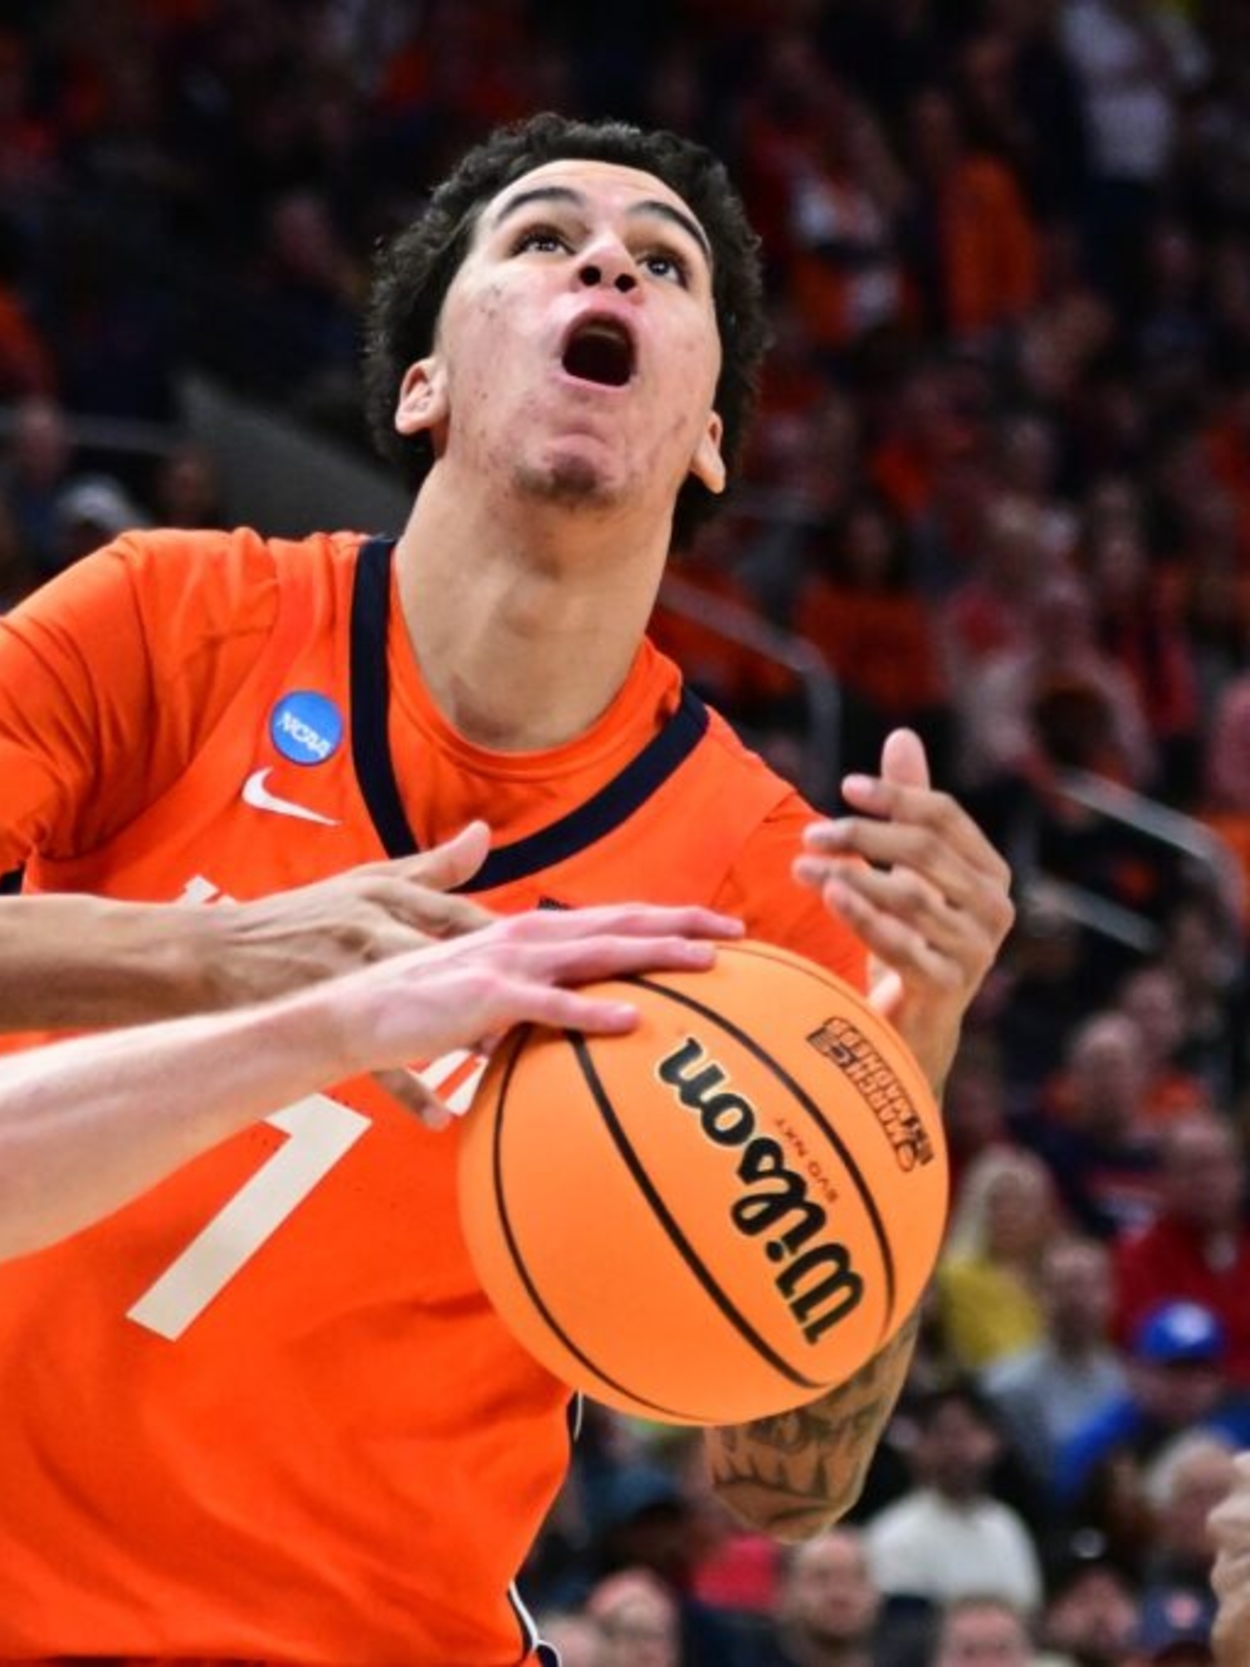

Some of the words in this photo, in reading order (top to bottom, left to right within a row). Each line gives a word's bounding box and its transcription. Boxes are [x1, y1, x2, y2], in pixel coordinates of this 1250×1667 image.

[277, 711, 331, 759] NCAA
[773, 1117, 809, 1158] NXT
[657, 1036, 865, 1346] Wilson
[807, 1160, 839, 1204] EVO
